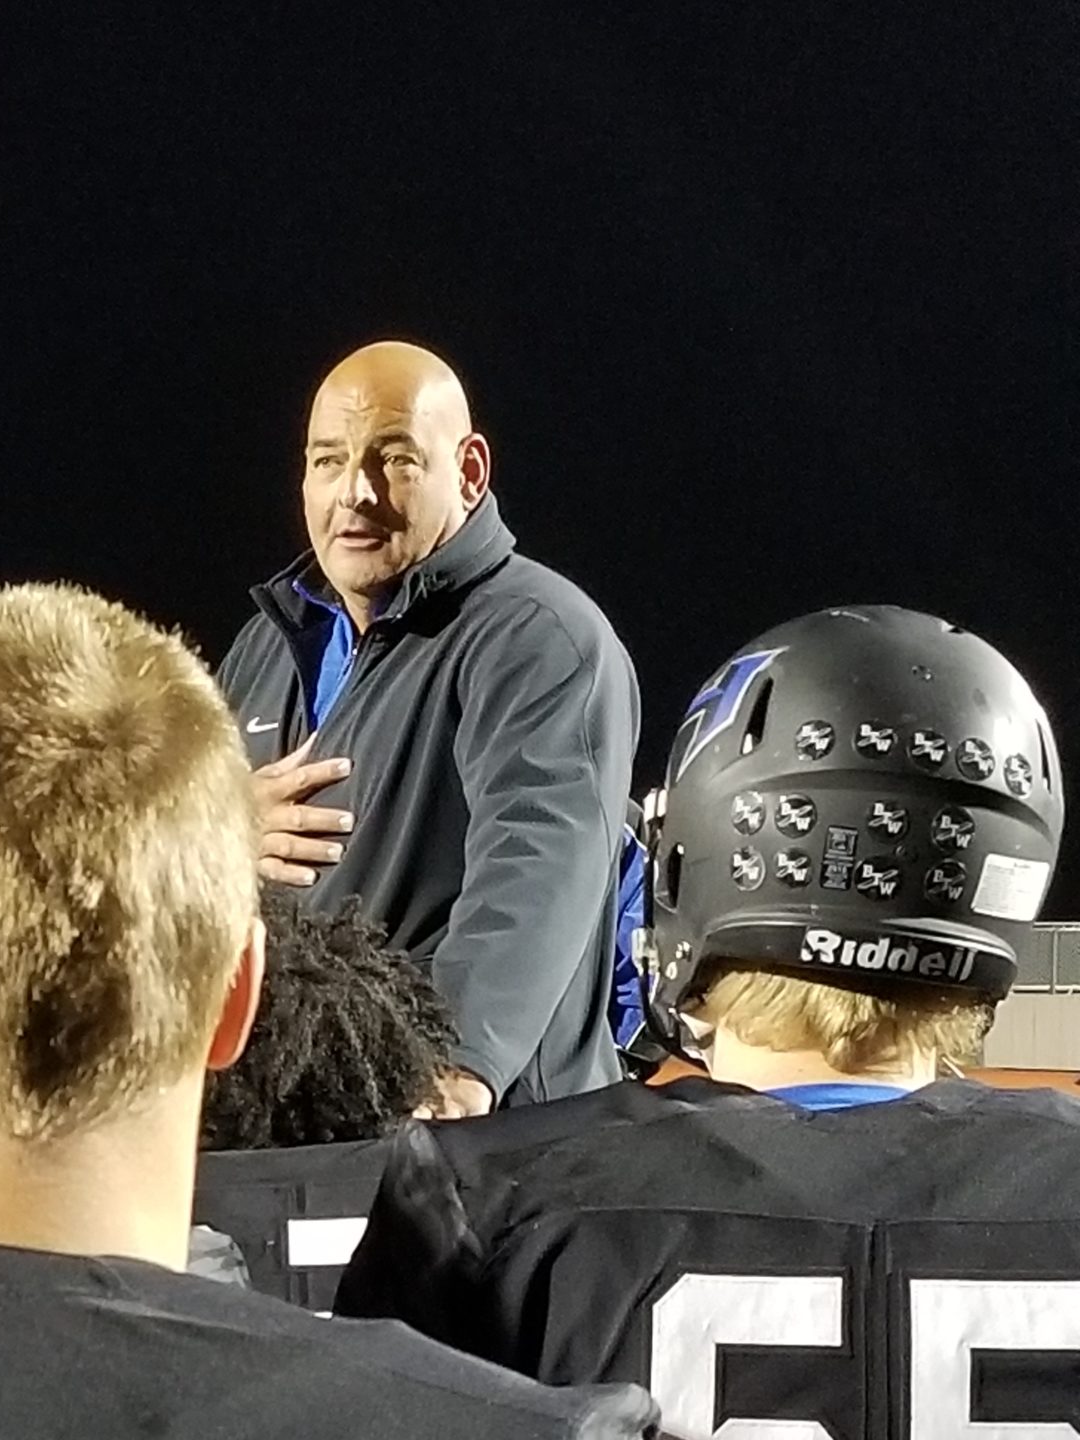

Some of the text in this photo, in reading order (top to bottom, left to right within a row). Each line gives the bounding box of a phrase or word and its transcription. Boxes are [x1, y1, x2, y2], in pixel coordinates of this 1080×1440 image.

[872, 802, 903, 834] BTW
[939, 815, 972, 848] BTW
[861, 863, 897, 896] BTW
[932, 869, 964, 899] BTW
[800, 928, 977, 982] Riddell
